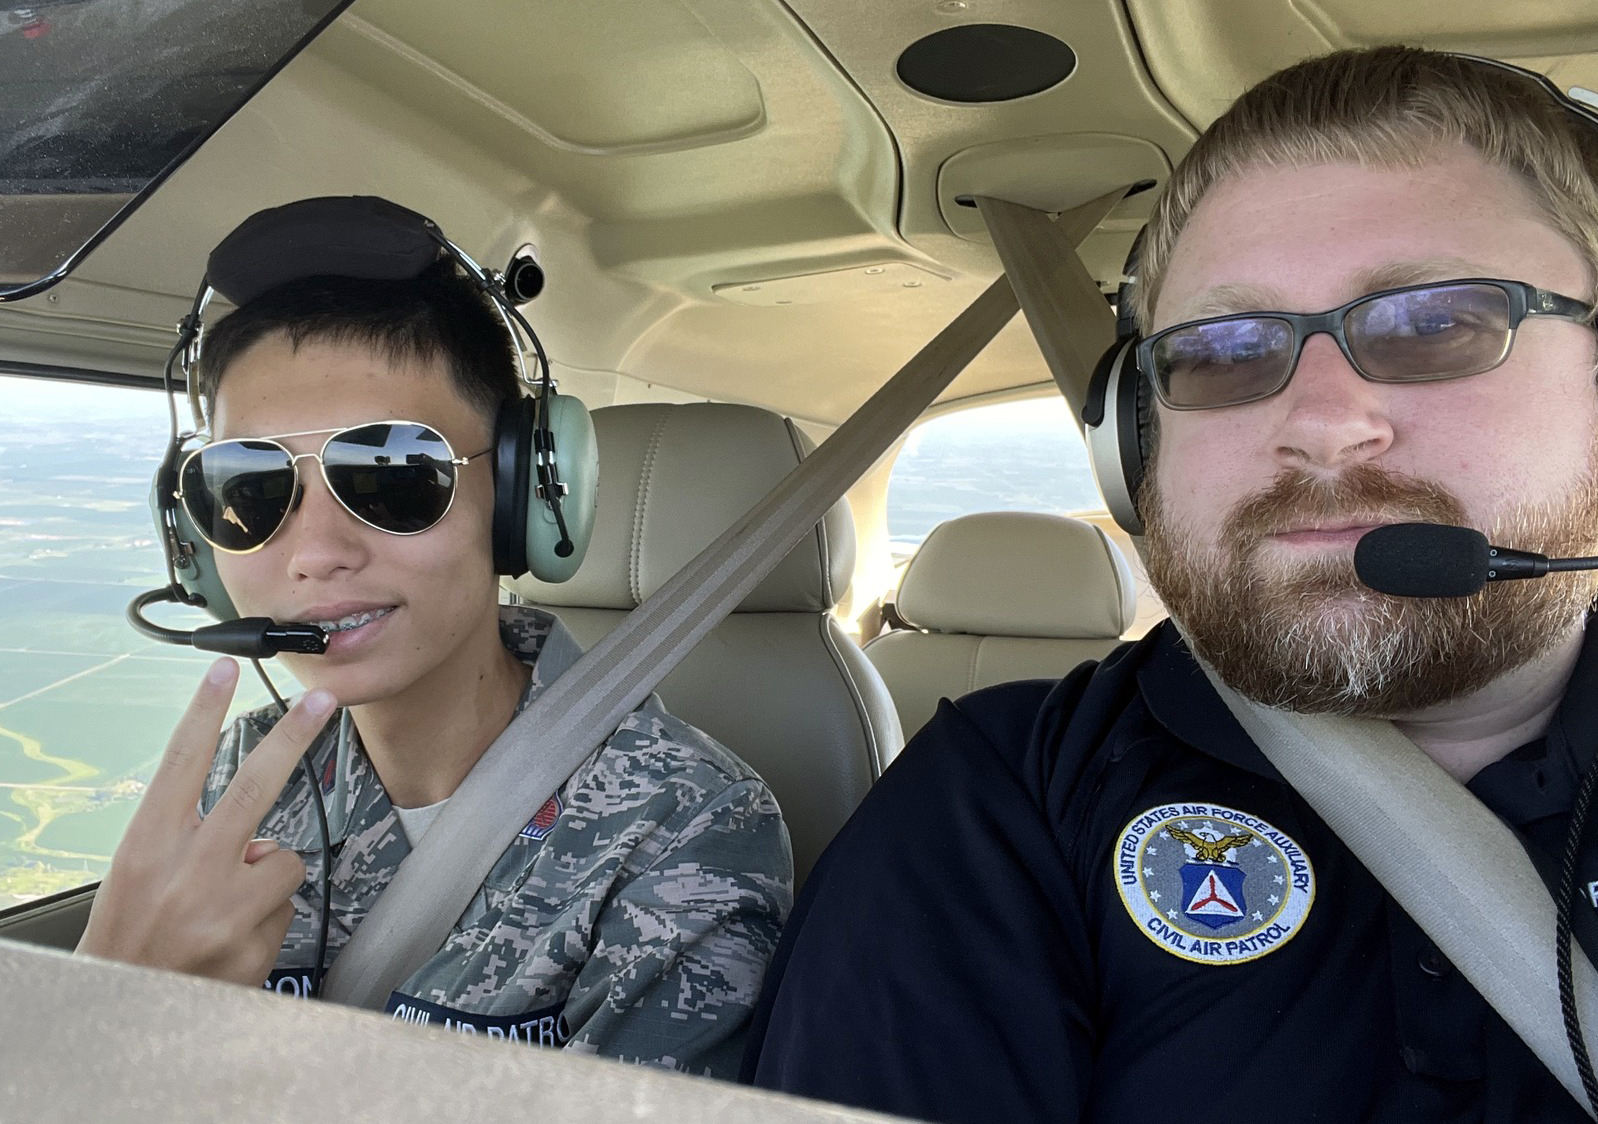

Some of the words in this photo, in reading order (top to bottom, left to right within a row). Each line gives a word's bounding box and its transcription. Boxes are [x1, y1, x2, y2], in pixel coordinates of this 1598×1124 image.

[1120, 834, 1139, 885] UNITED
[1132, 806, 1180, 835] STATES
[1182, 806, 1208, 816] AIR
[1211, 808, 1268, 833] FORCE
[1265, 831, 1310, 894] AUXILIARY
[1147, 916, 1186, 950] CIVIL
[1190, 941, 1222, 956] AIR
[1227, 922, 1291, 956] PATROL
